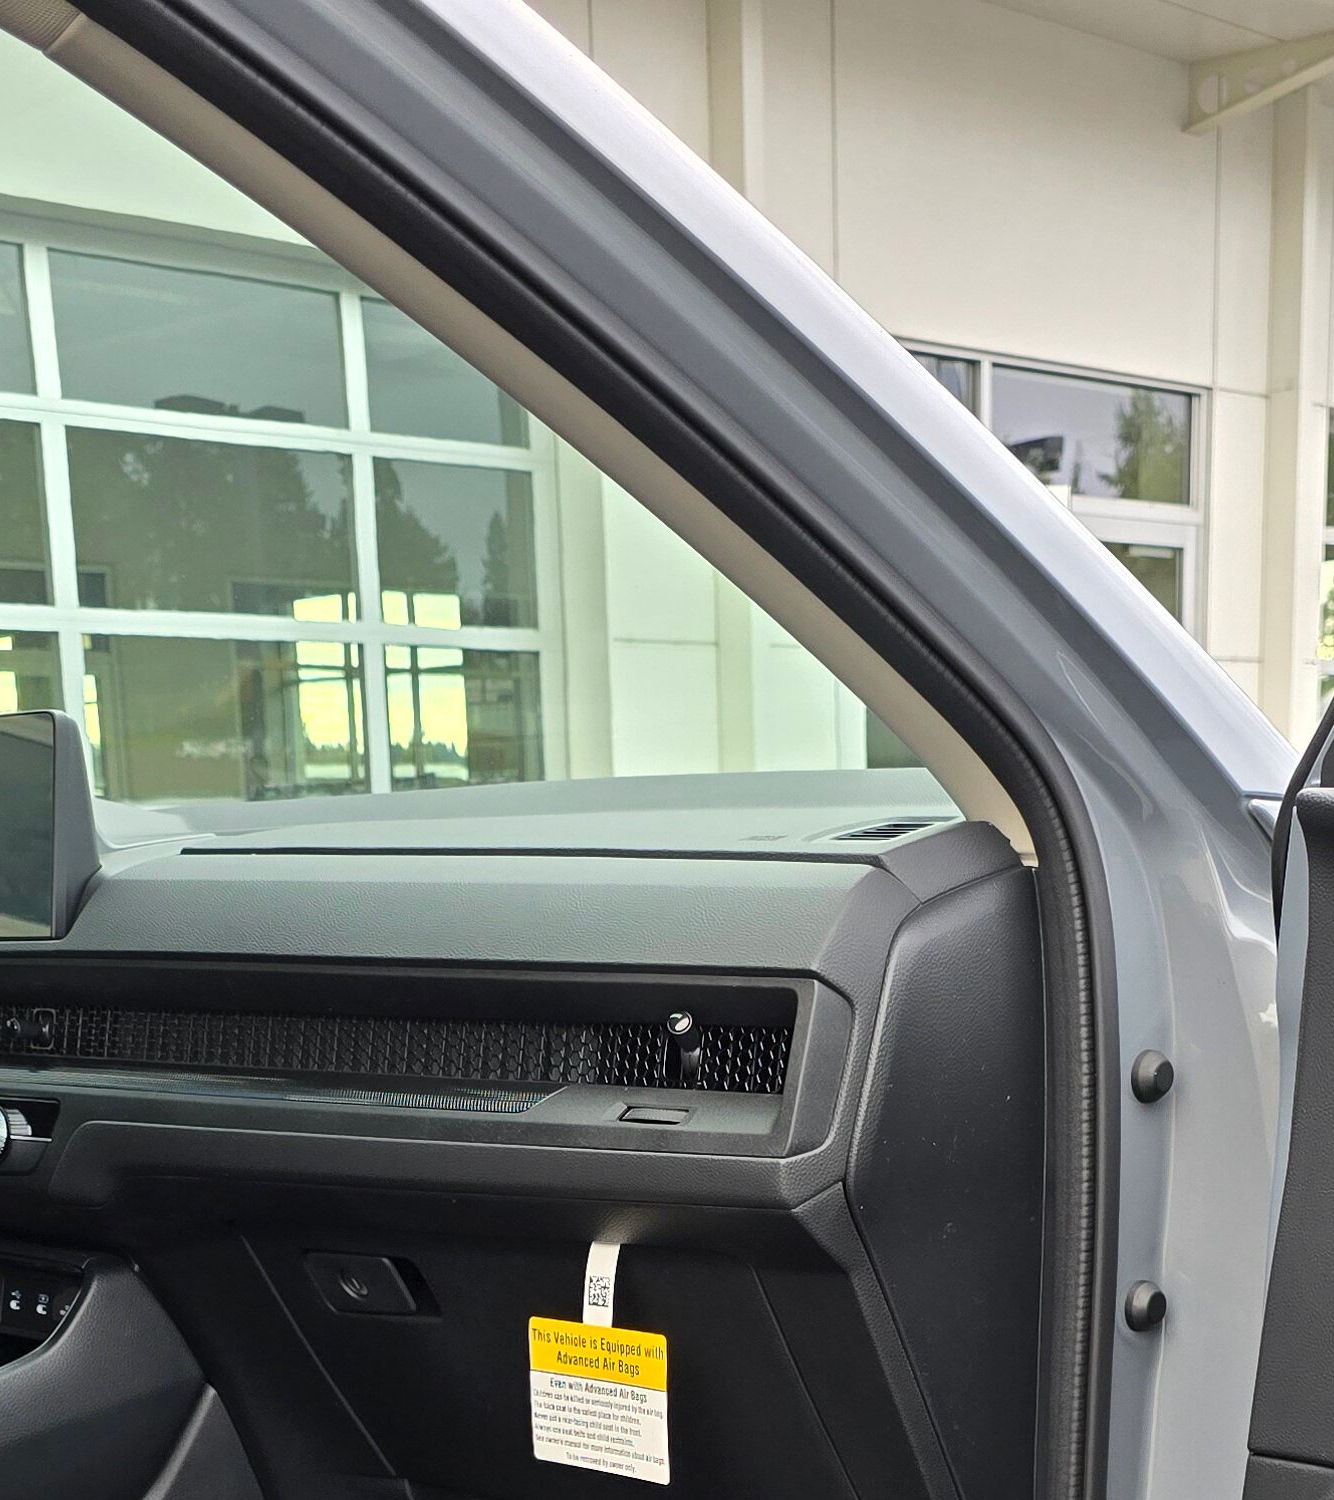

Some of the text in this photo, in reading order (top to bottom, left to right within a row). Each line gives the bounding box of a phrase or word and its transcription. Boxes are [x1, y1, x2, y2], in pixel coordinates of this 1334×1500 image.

[532, 1329, 663, 1360] This Vehicle is Equipped with
[557, 1351, 639, 1377] Advanced Air Bags
[550, 1378, 647, 1404] Even with Advanced Air Bags
